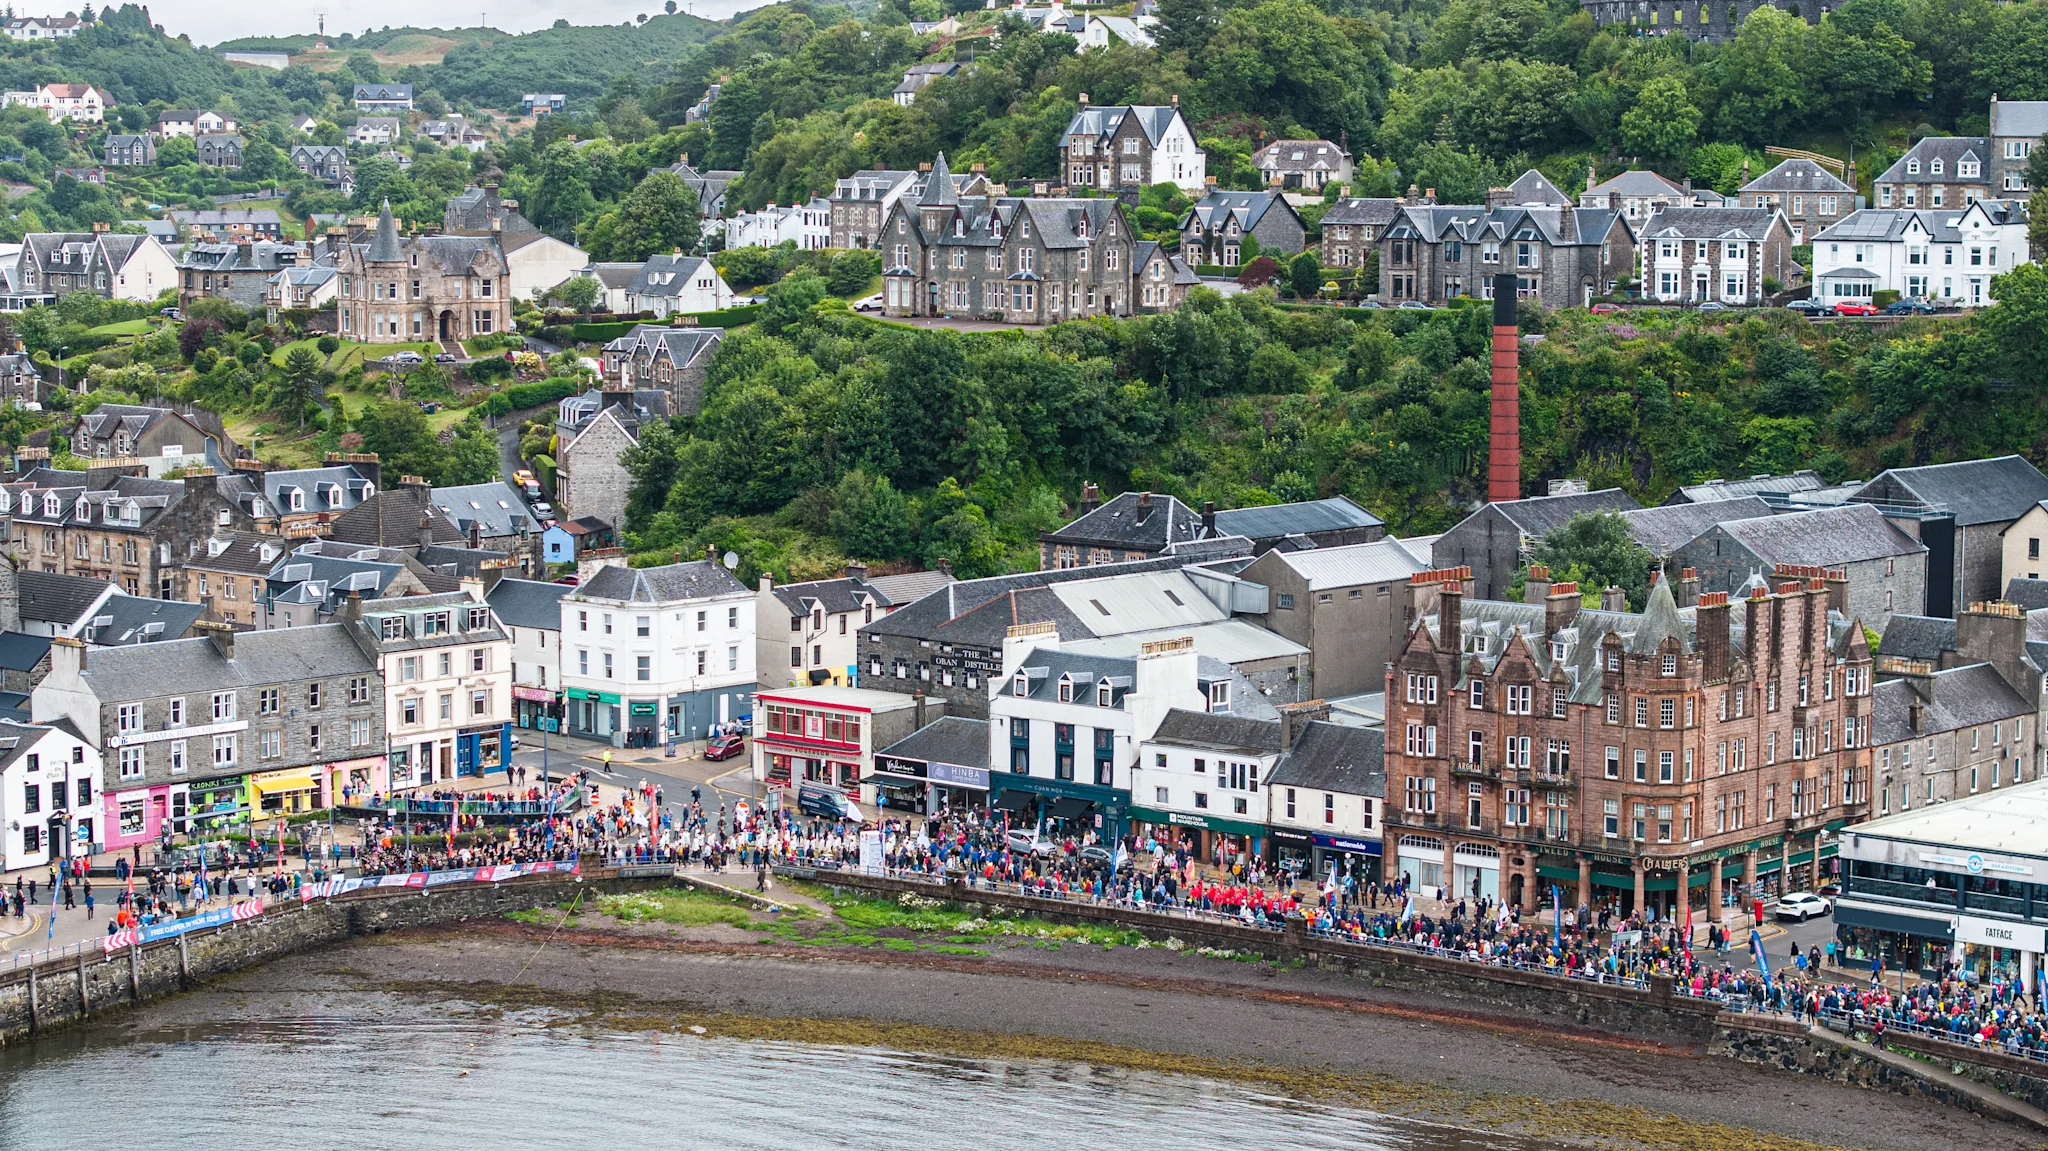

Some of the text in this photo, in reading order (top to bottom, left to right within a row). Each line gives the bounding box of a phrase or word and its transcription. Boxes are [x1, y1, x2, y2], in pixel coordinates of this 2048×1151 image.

[962, 650, 980, 659] THE
[935, 657, 1003, 671] OBAN DISTILLE
[130, 732, 167, 743] MORHAM
[176, 725, 213, 737] BROTCHIE
[951, 767, 981, 778] HINBA
[191, 779, 220, 789] KRONKS
[1177, 814, 1203, 822] MOUNTAIN
[1177, 819, 1208, 828] WAREHOUSE
[1335, 840, 1366, 850] nationwide
[1691, 838, 1779, 864] HIGHLAND TWEED HOUSE
[1539, 846, 1623, 864] TWEED HOUSE
[1642, 856, 1689, 871] CHALMERS
[150, 926, 164, 936] FREE
[206, 914, 220, 923] TOUR
[1985, 927, 2013, 940] FATFACE
